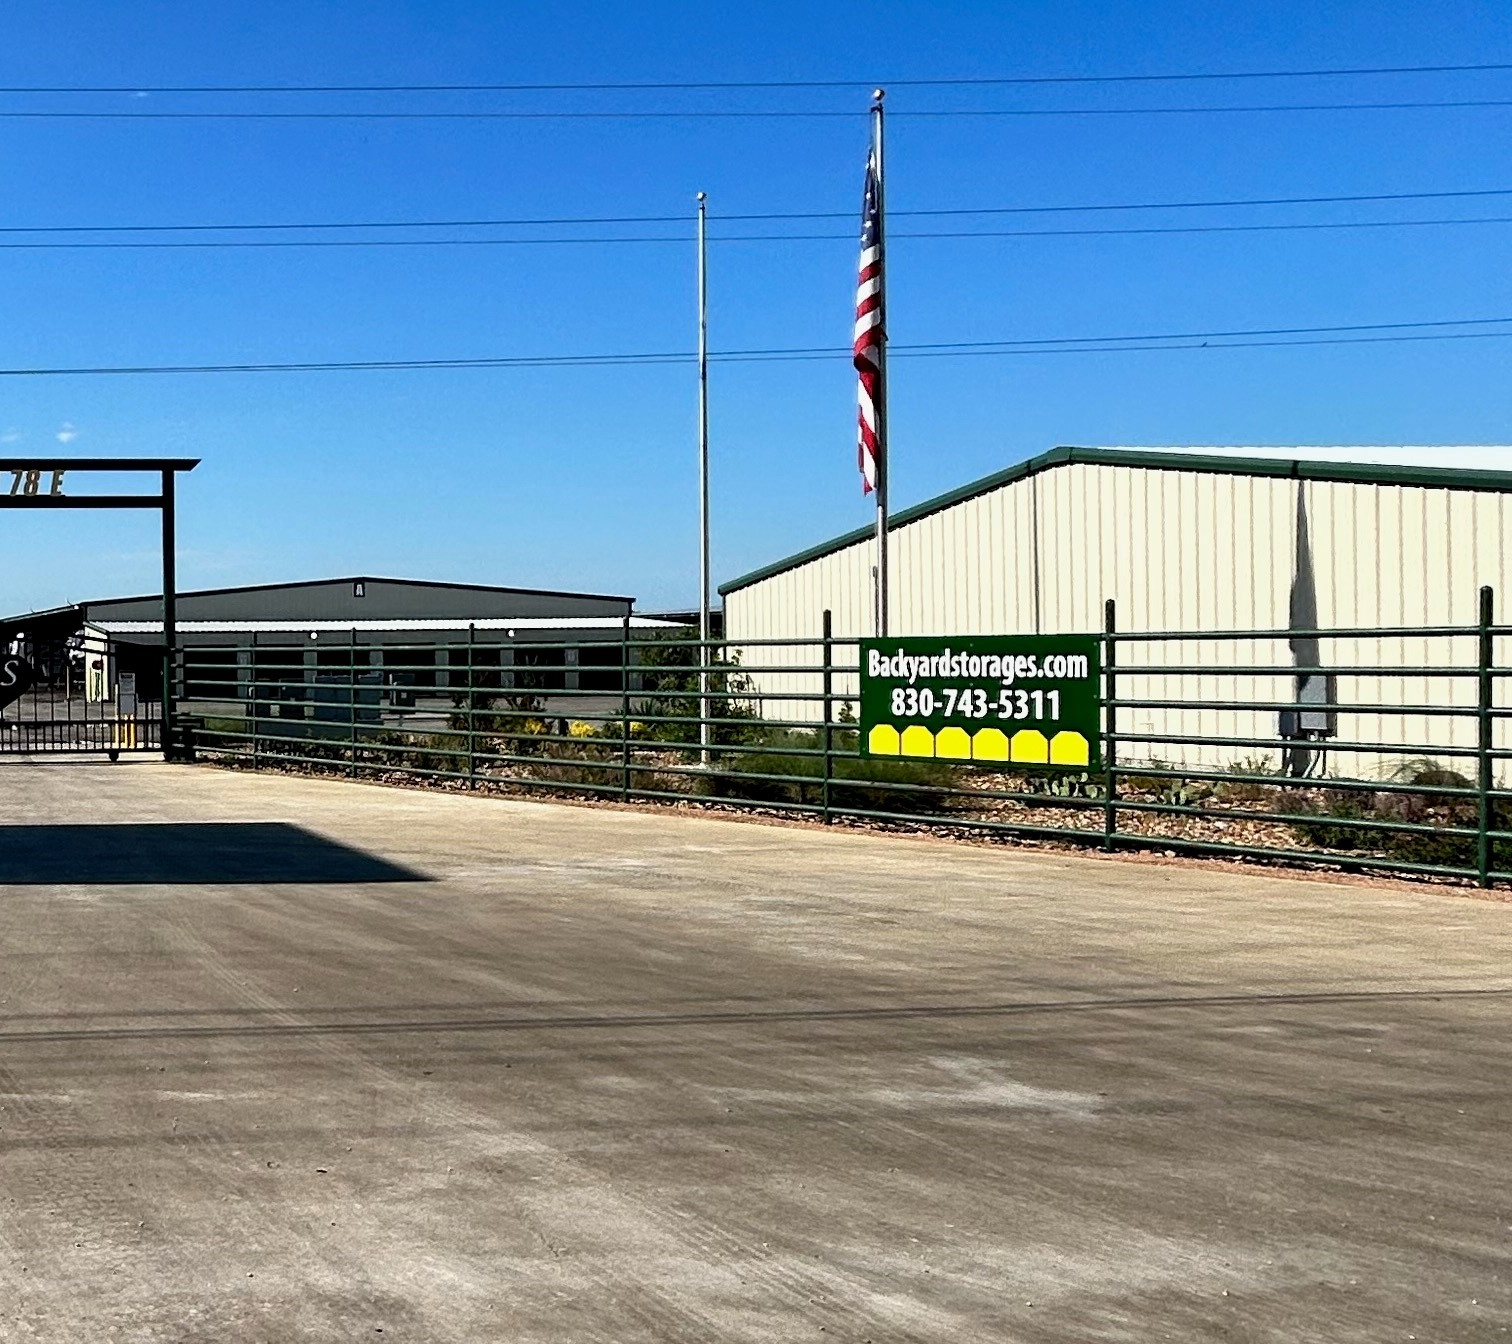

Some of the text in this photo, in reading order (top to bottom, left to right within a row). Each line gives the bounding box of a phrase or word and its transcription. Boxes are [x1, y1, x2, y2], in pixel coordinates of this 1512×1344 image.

[10, 469, 41, 497] 78
[50, 469, 65, 497] E
[868, 648, 1088, 685] Backyardstorages.com
[891, 688, 1060, 720] 830-743-5311
